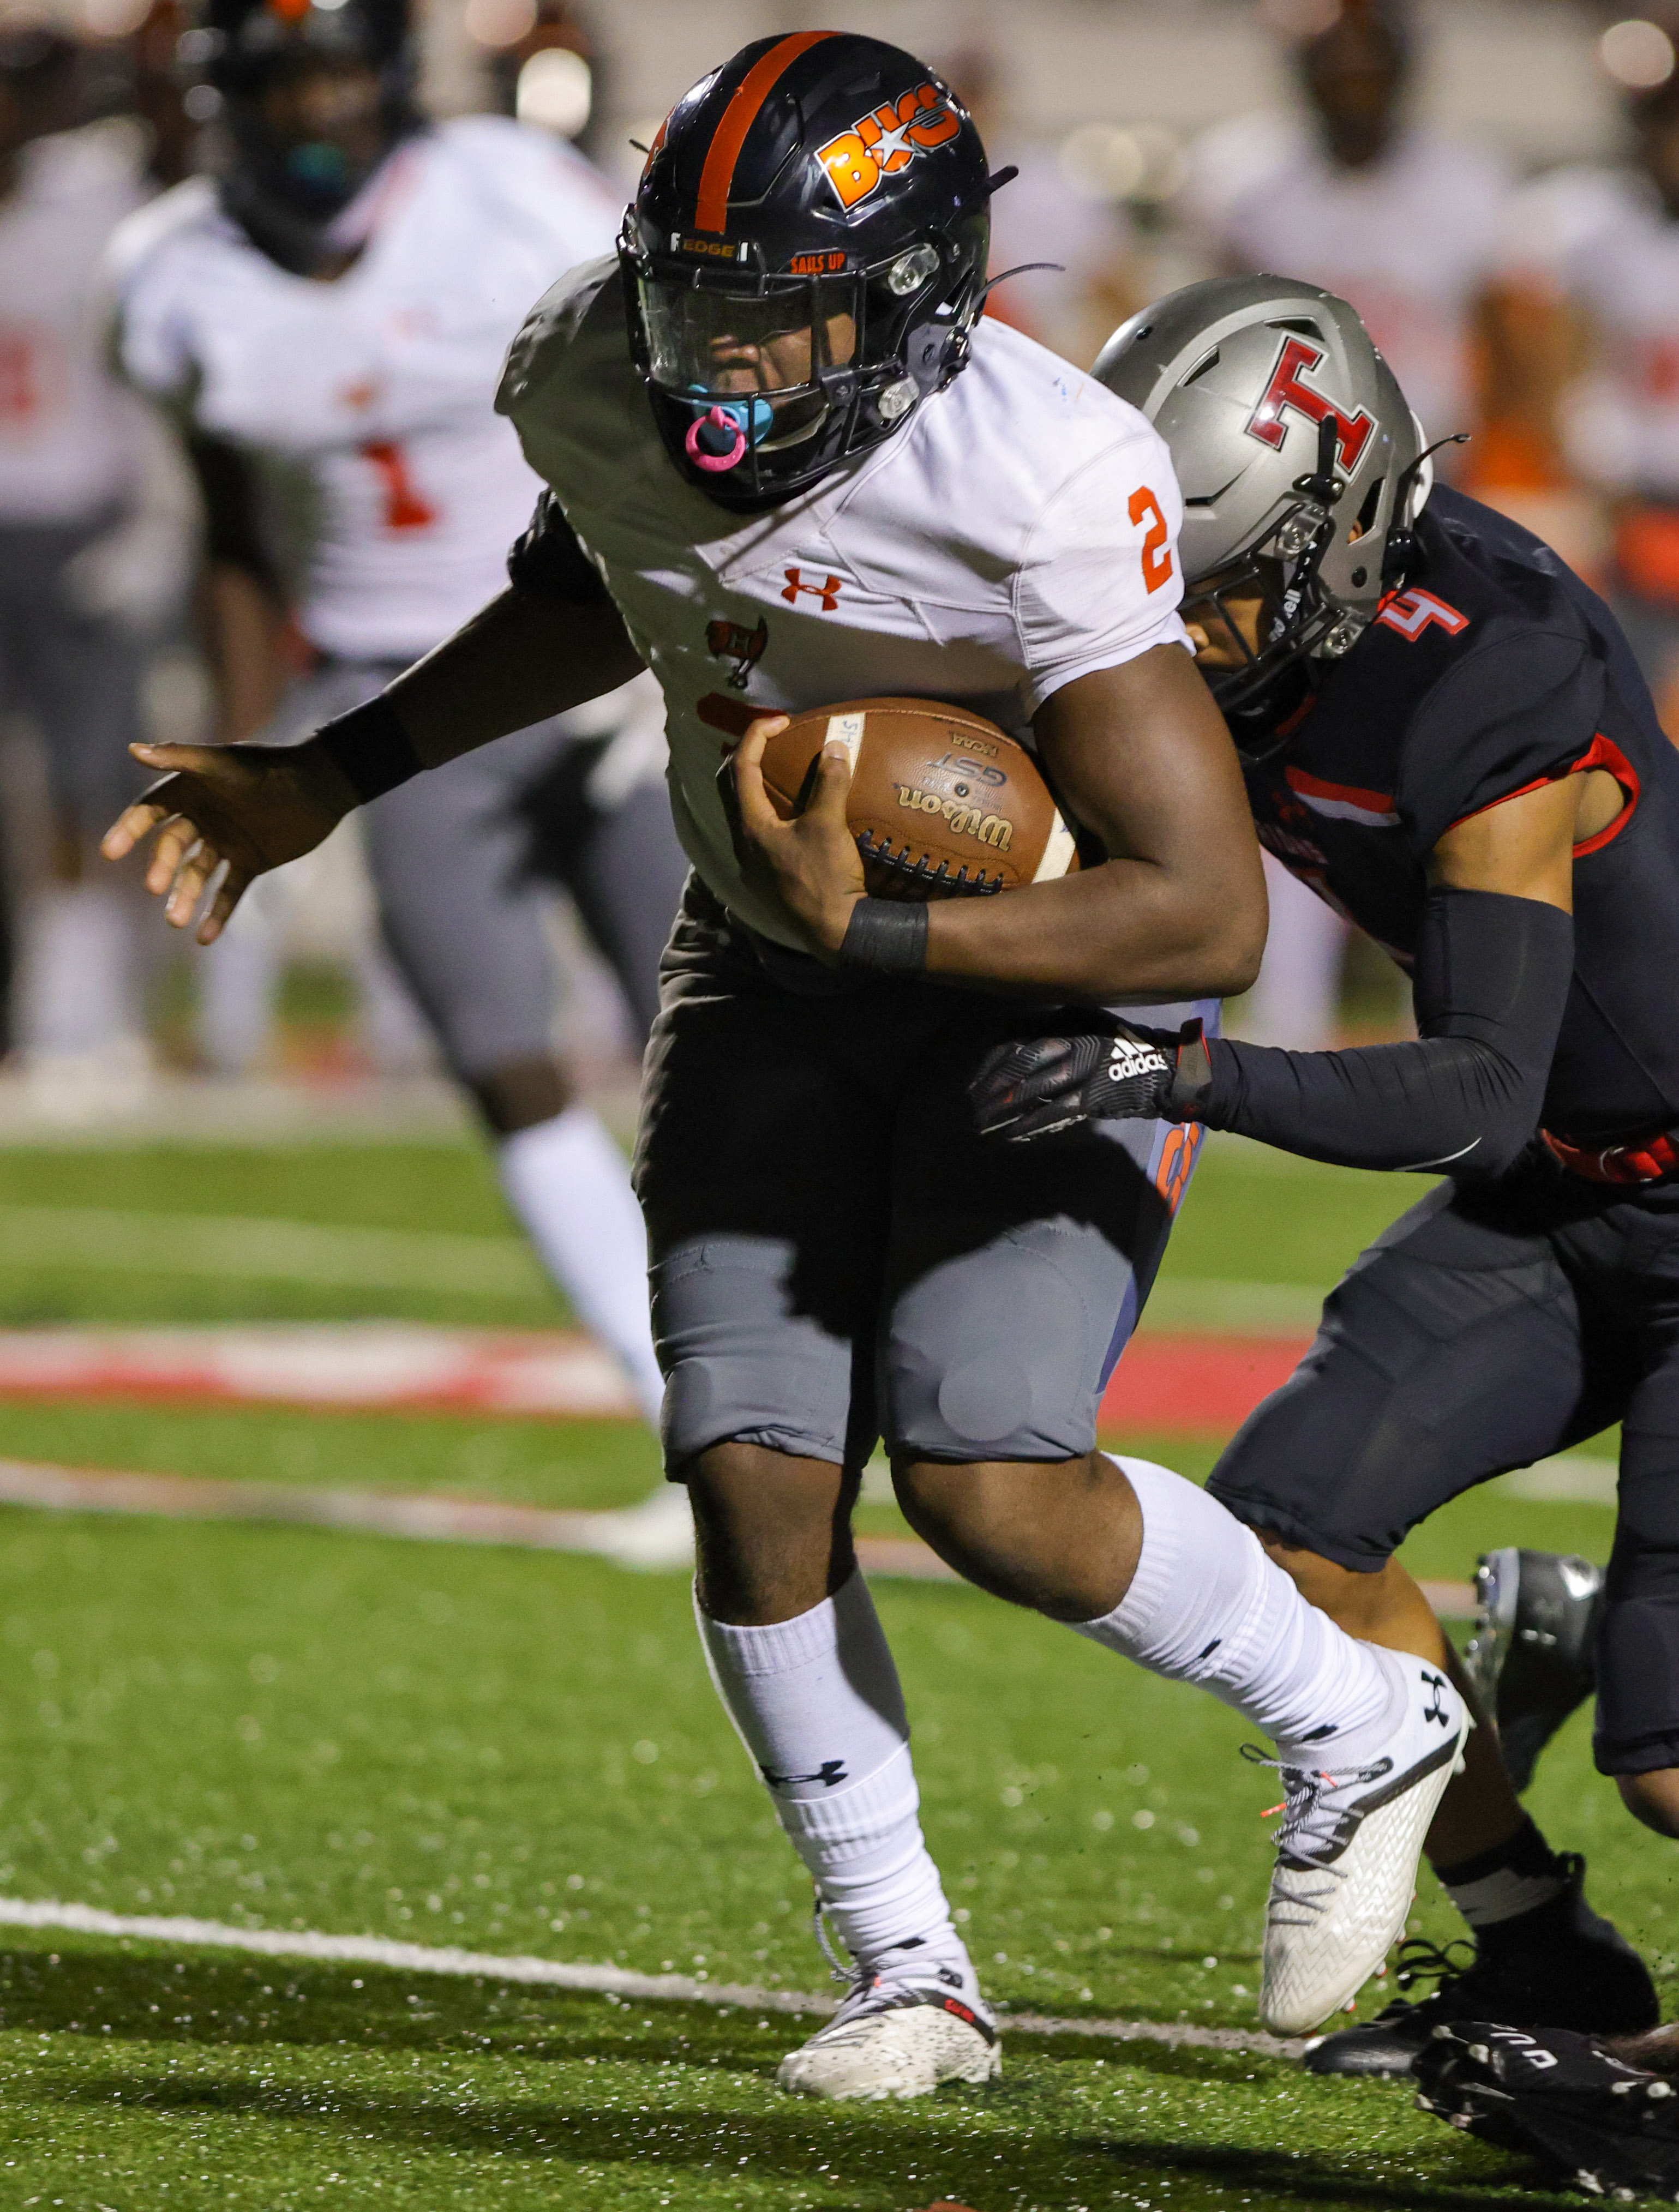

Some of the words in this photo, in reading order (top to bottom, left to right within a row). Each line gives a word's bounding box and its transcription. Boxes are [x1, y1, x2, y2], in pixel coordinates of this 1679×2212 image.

[683, 238, 735, 258] EDGE
[790, 255, 824, 274] SAILS
[827, 253, 845, 270] UP
[1243, 330, 1380, 486] T
[1128, 486, 1173, 595] 2
[1374, 587, 1471, 642] 4
[951, 732, 999, 758] NCAA
[926, 752, 1008, 788] GST
[898, 785, 1014, 852] Wilson
[1108, 1053, 1168, 1082] adidas
